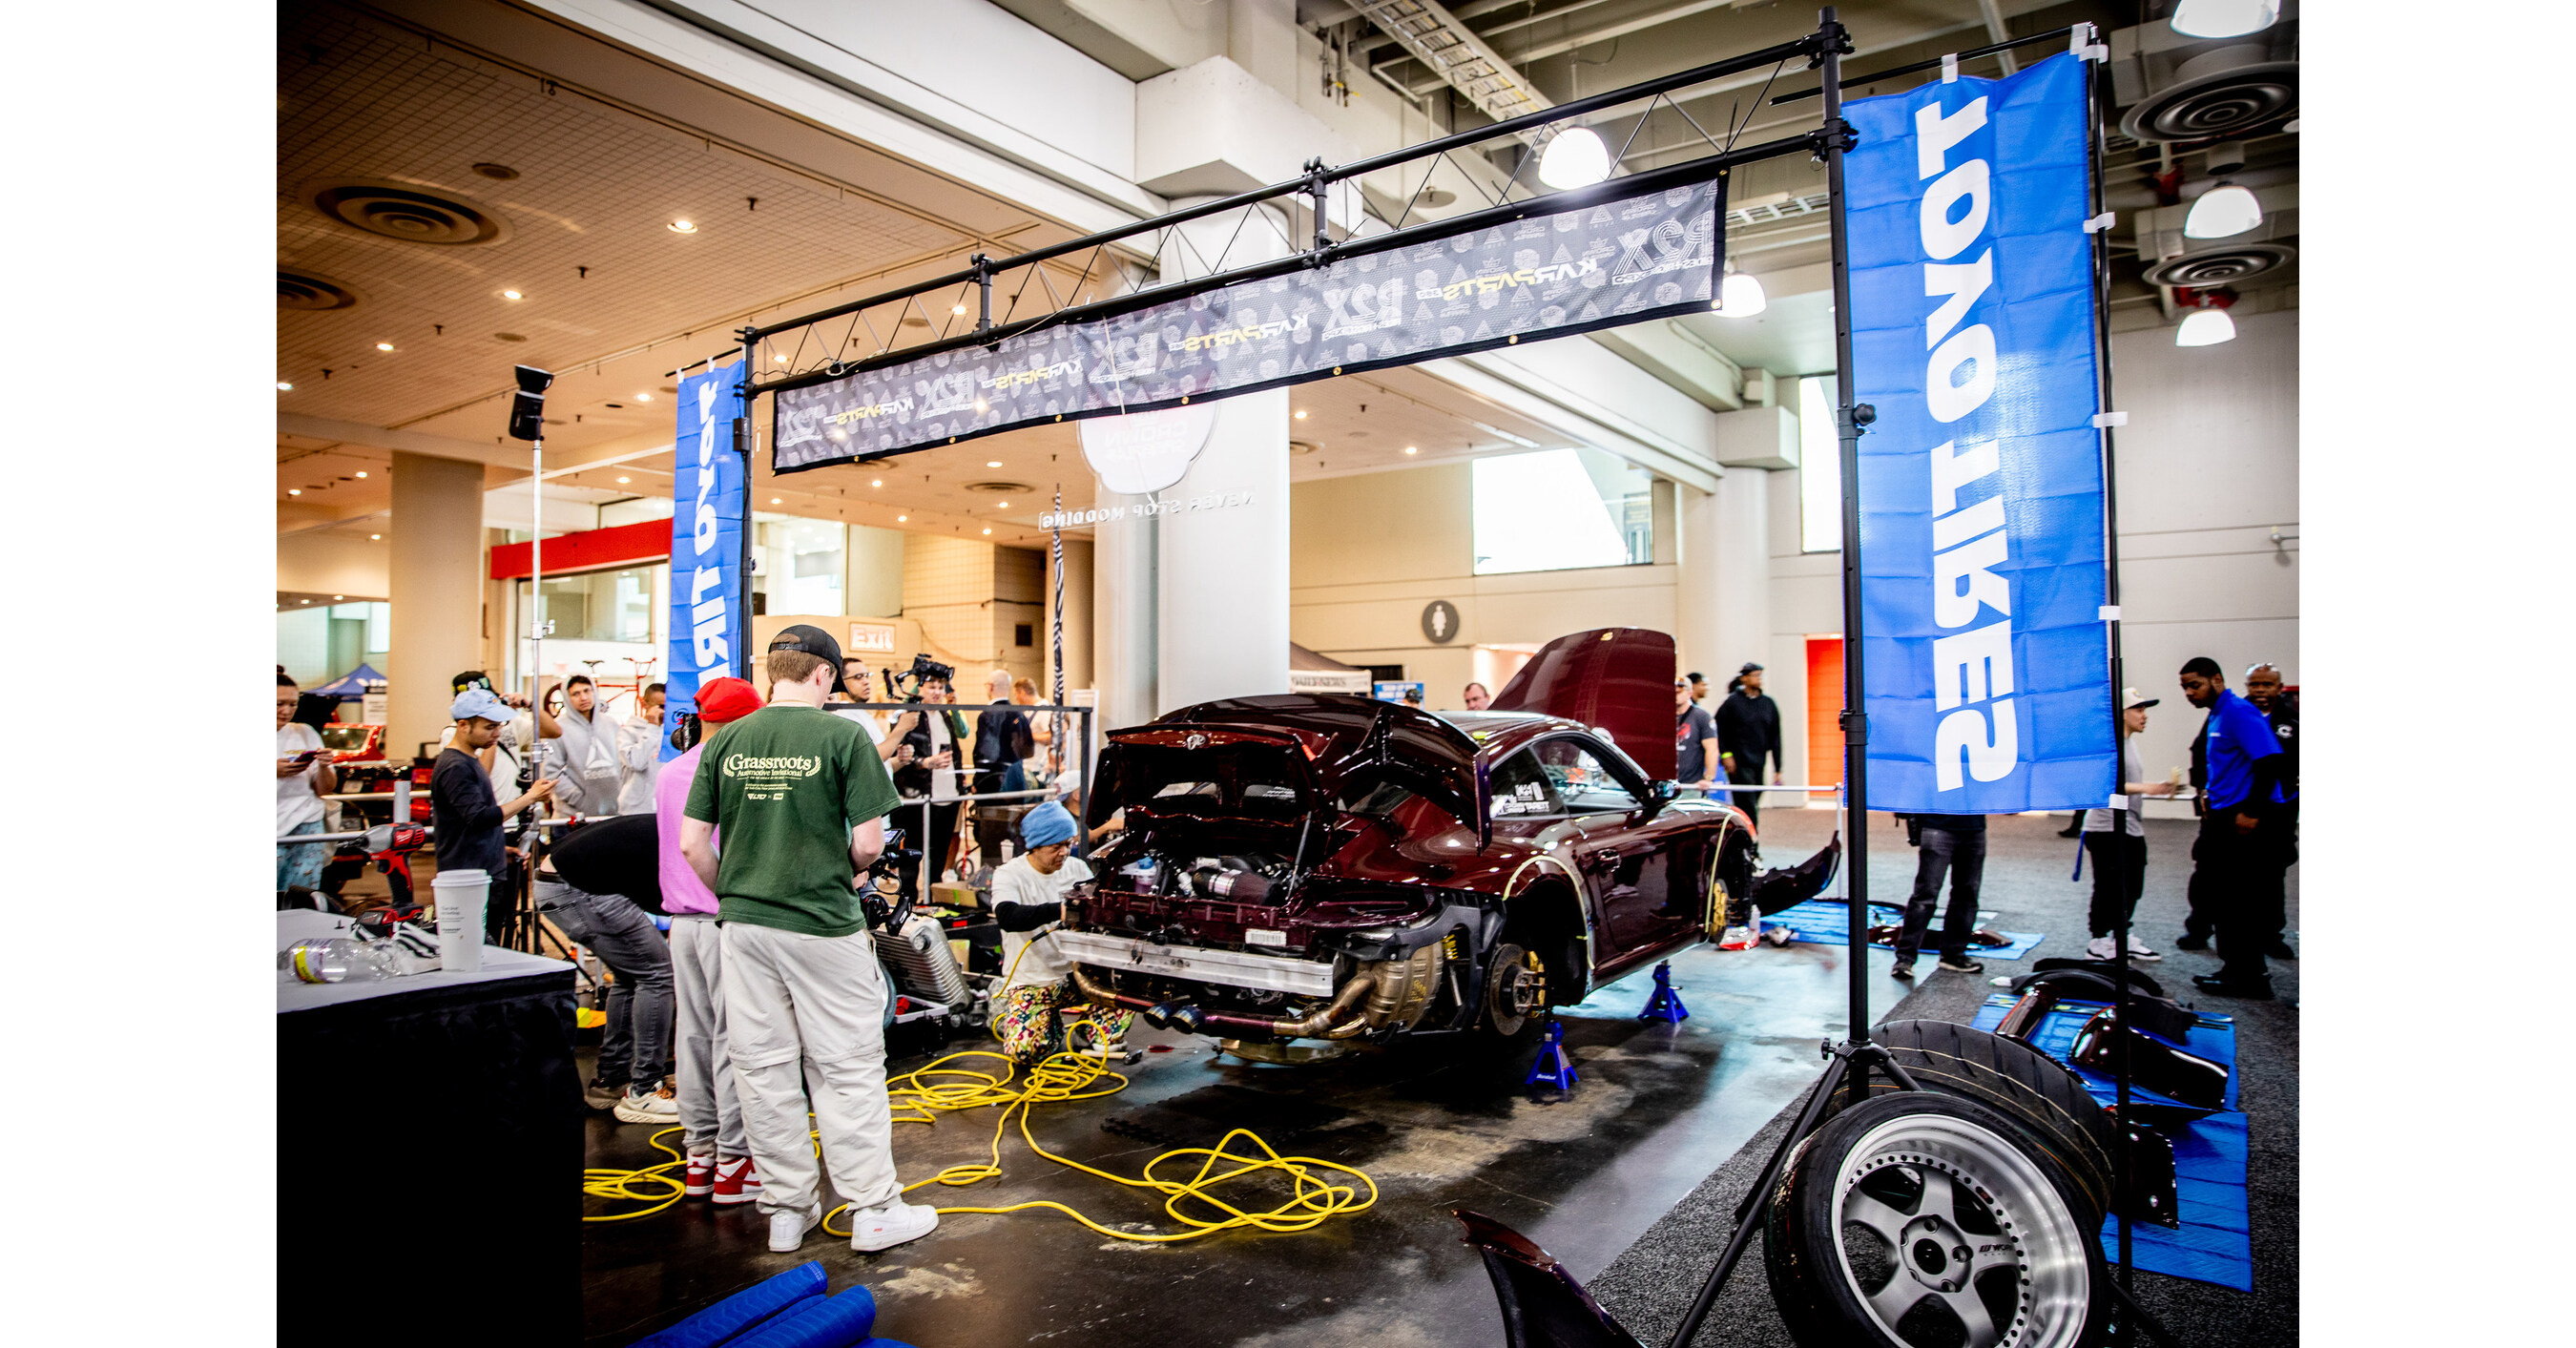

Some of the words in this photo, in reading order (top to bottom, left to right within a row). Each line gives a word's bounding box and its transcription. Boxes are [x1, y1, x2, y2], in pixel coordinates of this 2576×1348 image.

[851, 627, 894, 651] Exit
[728, 753, 812, 771] Grassroots
[737, 769, 771, 778] Automotive
[771, 768, 803, 778] Invitational
